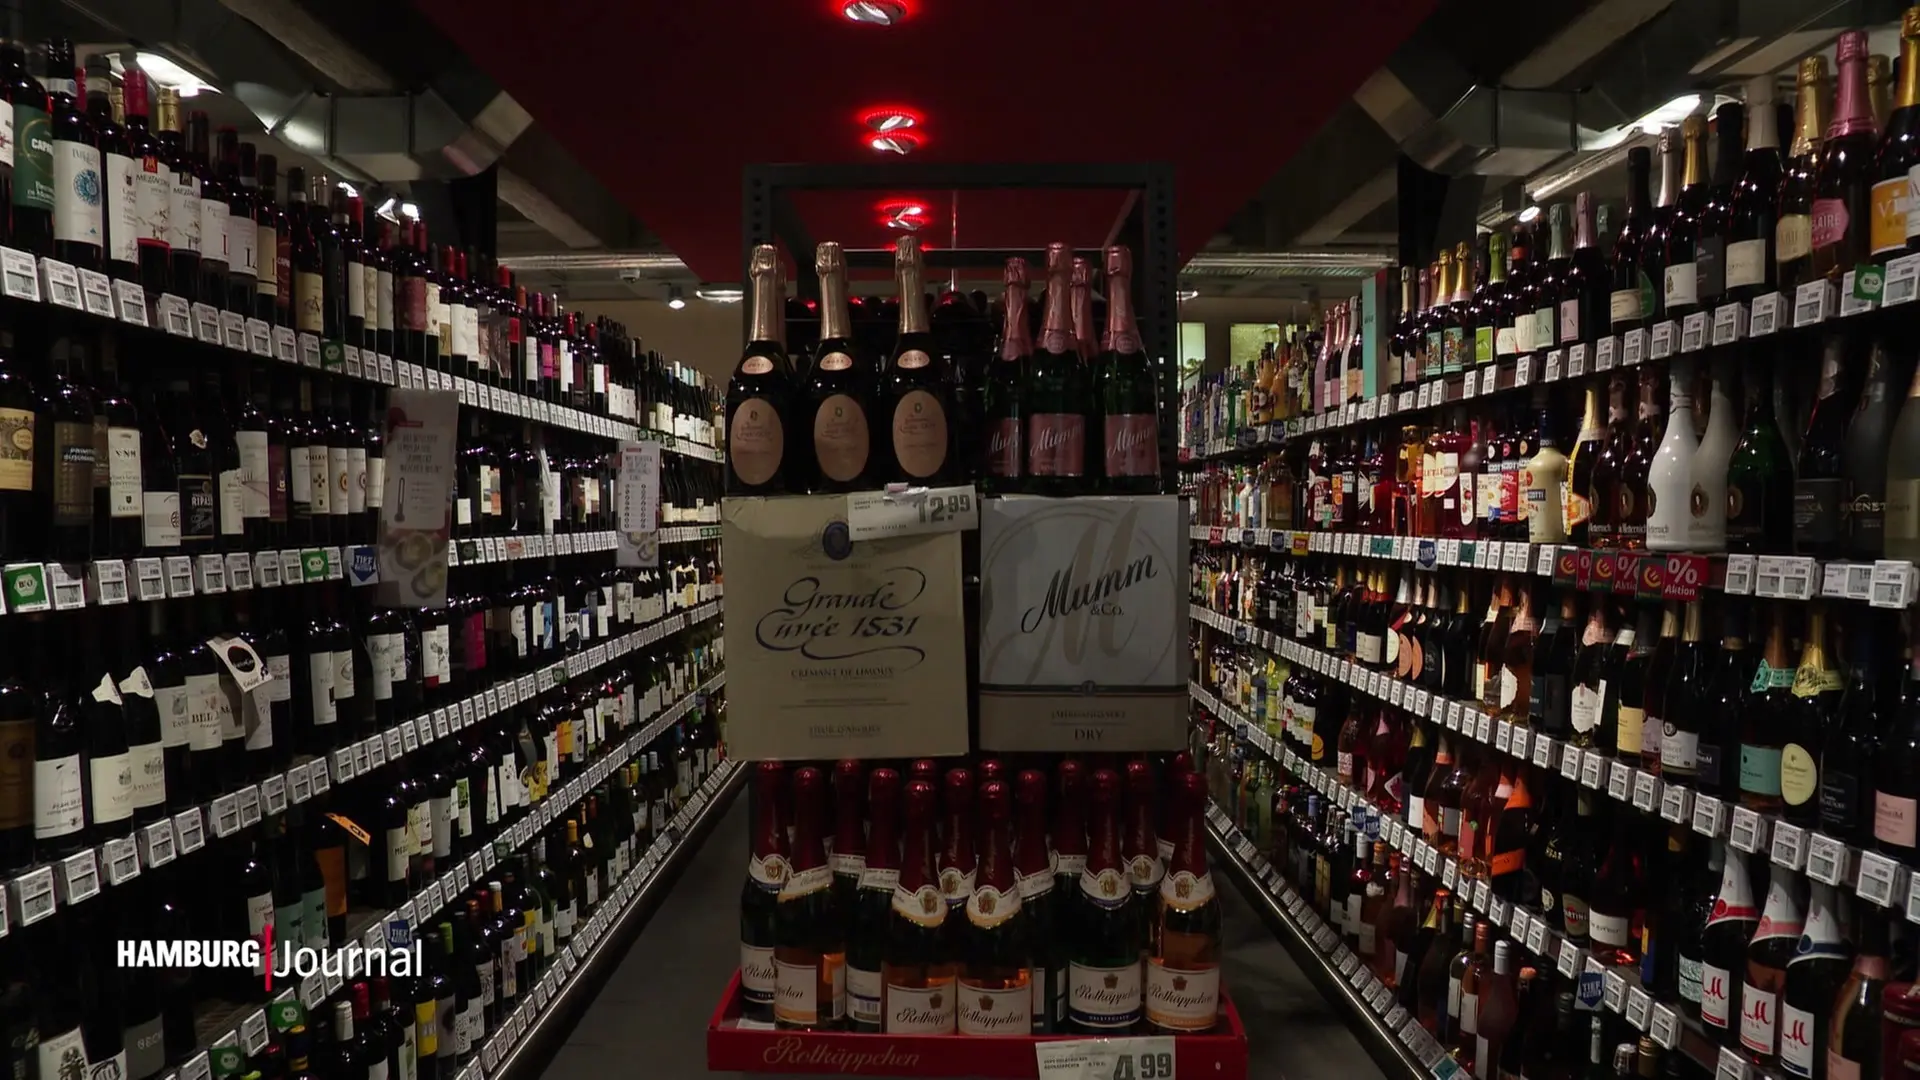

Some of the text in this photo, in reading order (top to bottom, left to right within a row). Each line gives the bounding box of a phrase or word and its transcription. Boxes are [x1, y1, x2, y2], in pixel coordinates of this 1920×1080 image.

[783, 570, 912, 618] Grande
[1021, 554, 1158, 633] Mumm
[1665, 584, 1696, 597] Aktion
[756, 609, 921, 650] Cuvée 1531
[1074, 728, 1104, 741] DRY
[763, 1037, 919, 1072] Rotkäppchen
